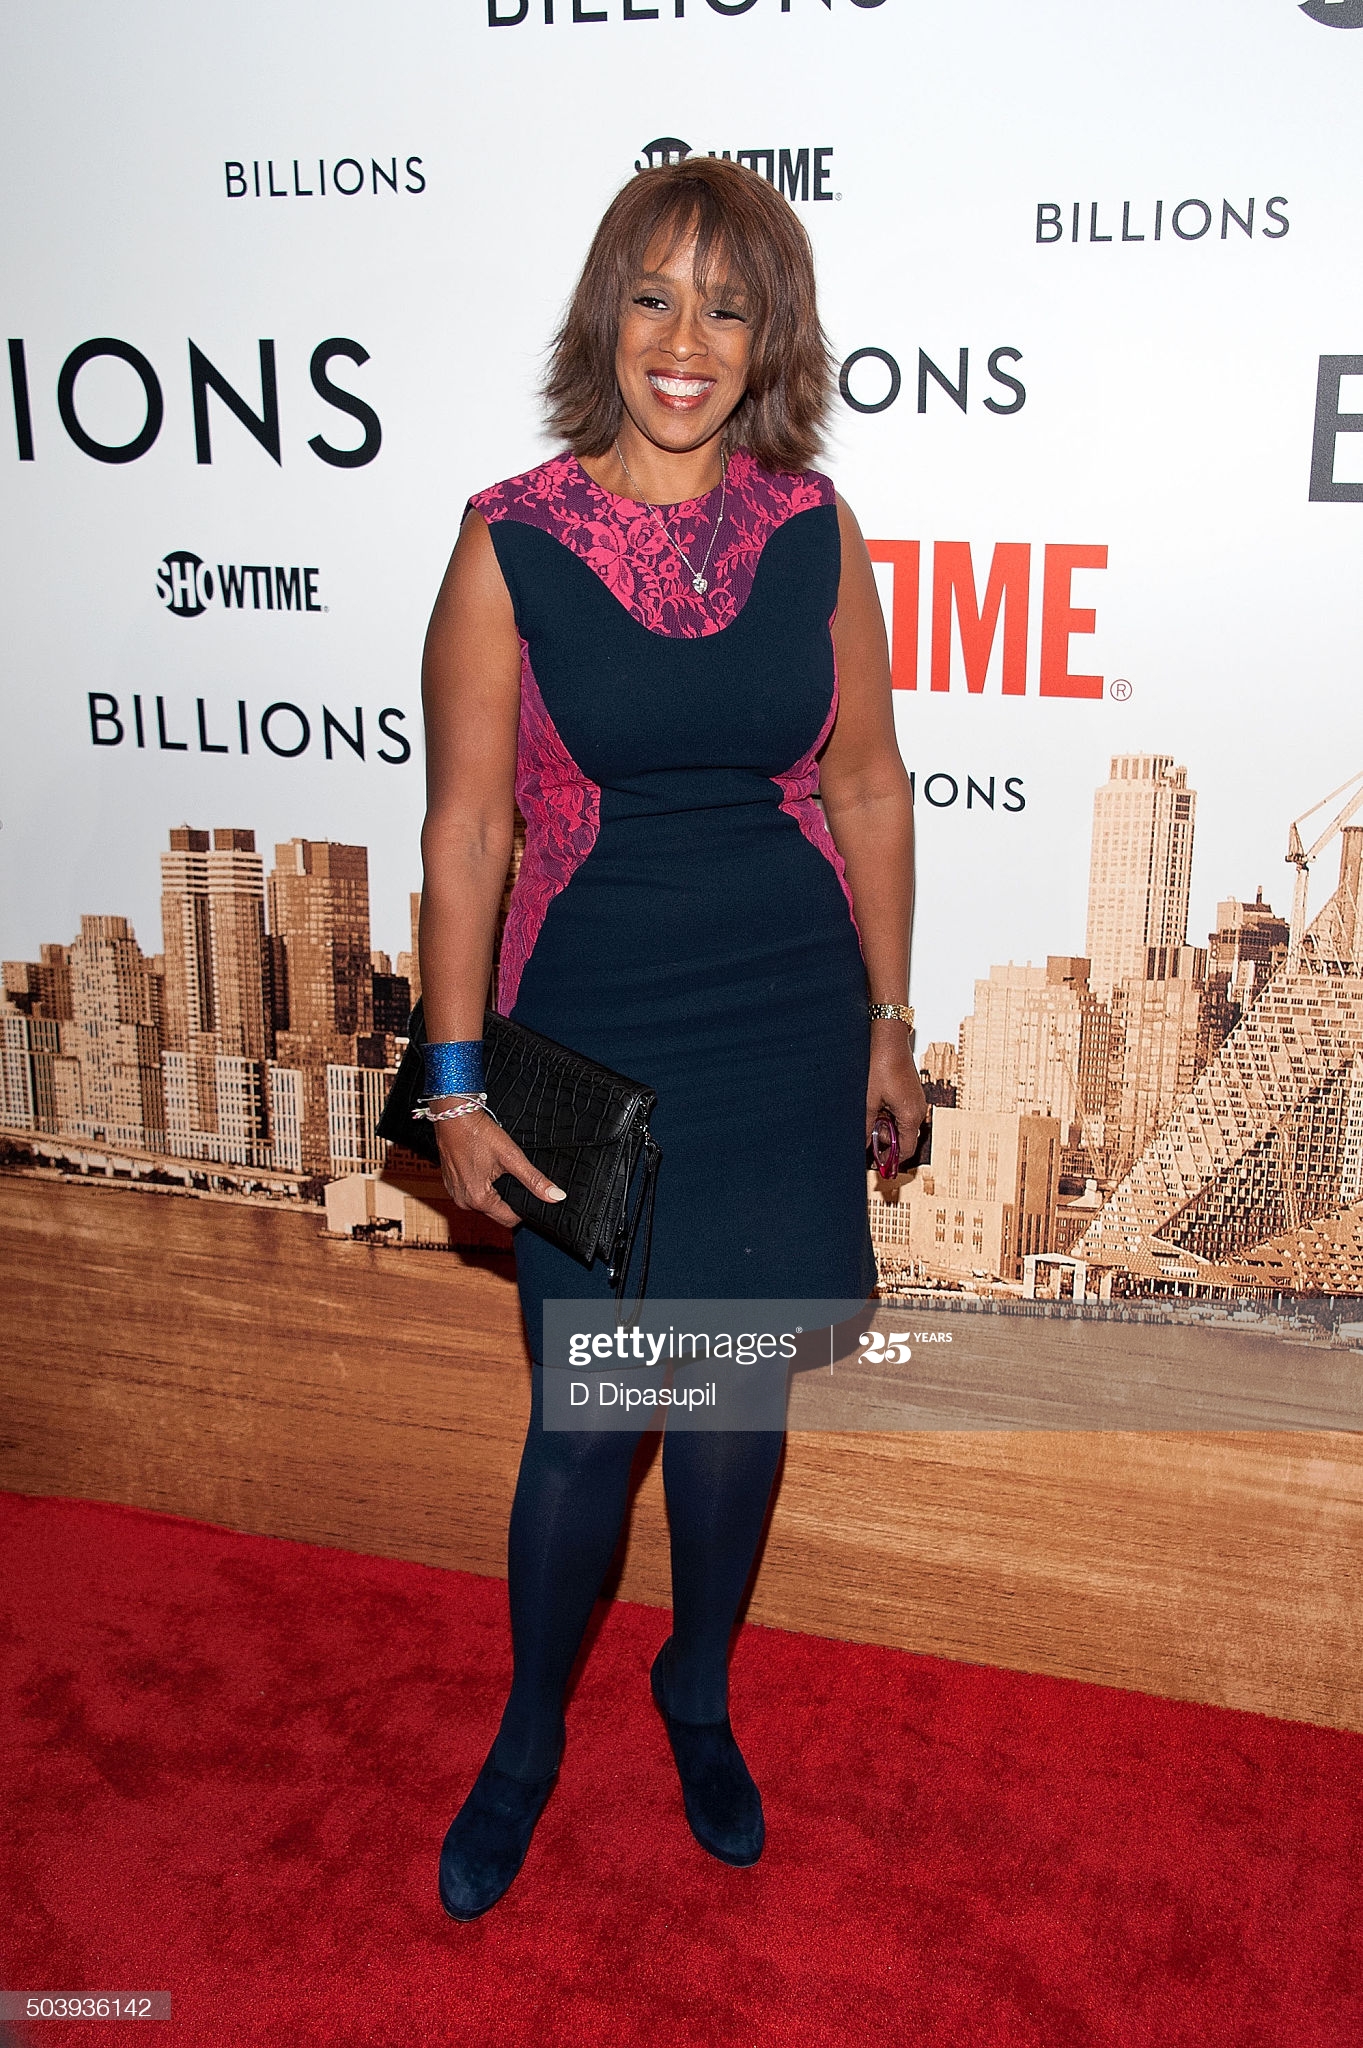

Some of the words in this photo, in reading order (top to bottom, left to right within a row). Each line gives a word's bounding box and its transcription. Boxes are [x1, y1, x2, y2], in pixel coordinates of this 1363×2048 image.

[224, 156, 426, 198] BILLIONS
[635, 137, 834, 201] TIME
[1035, 196, 1290, 244] BILLIONS
[7, 337, 382, 469] IONS
[156, 550, 322, 618] SHOWTIME
[87, 691, 411, 765] BILLIONS
